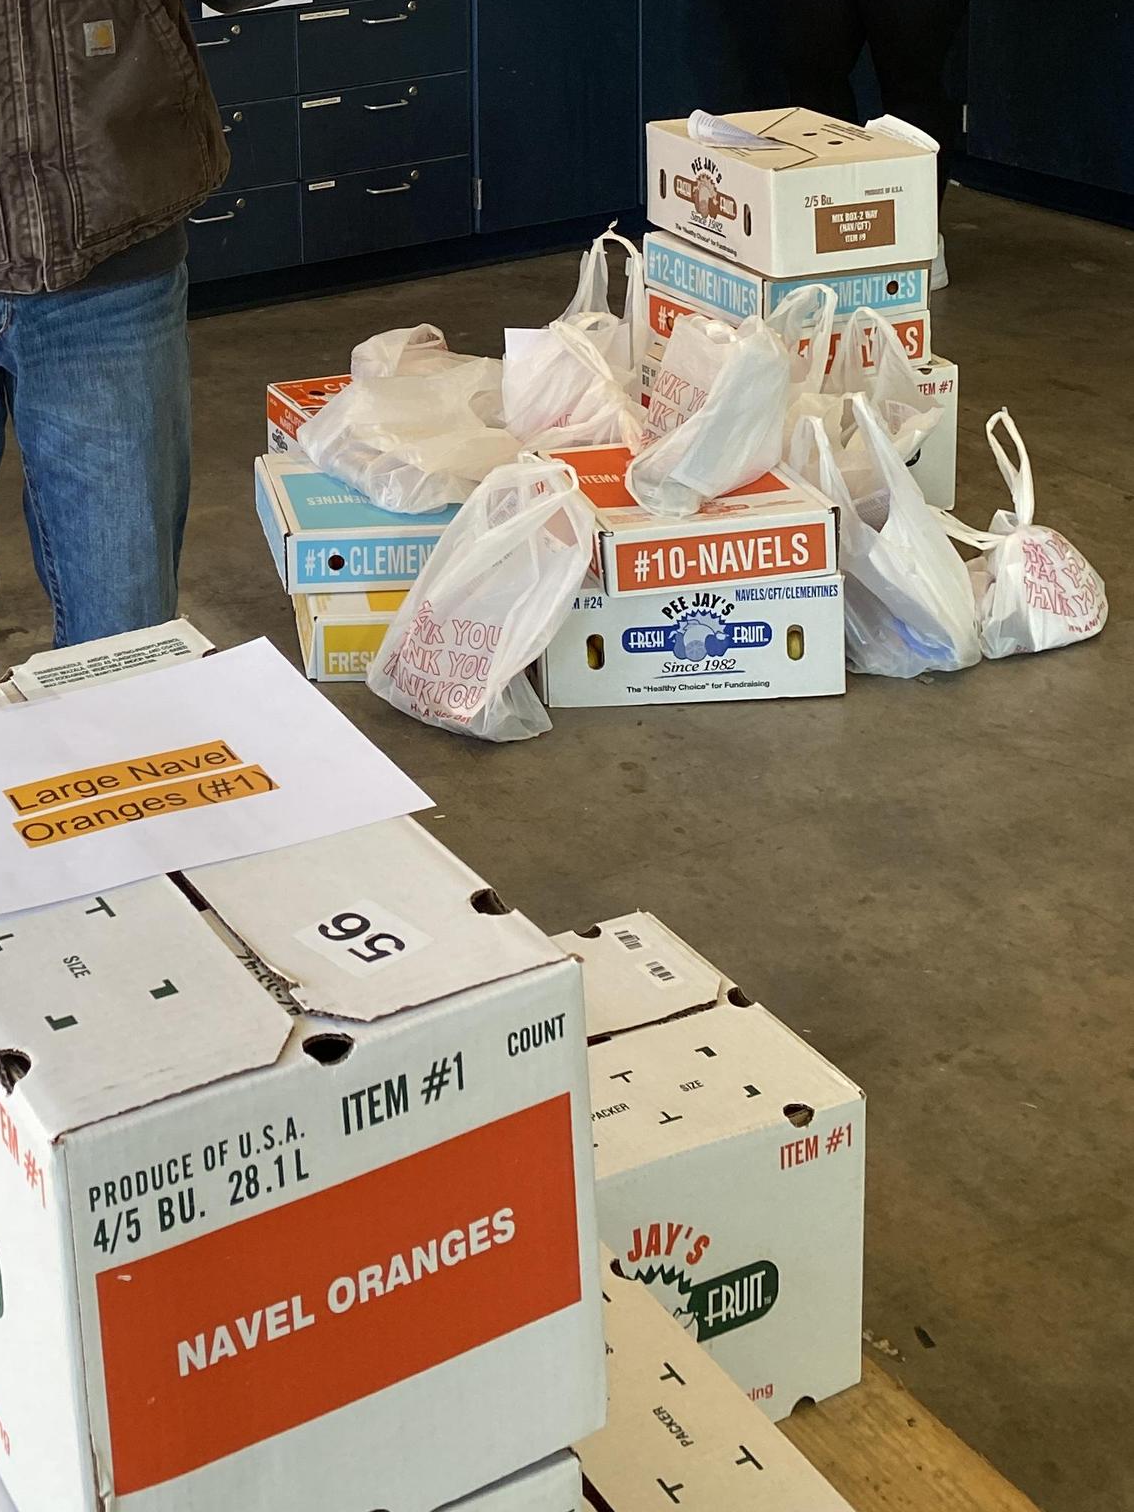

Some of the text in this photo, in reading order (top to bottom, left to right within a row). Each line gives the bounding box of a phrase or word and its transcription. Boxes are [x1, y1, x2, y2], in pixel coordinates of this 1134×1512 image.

[805, 195, 819, 208] 2/5
[832, 209, 878, 223] MIX BOX-2 WAY
[648, 246, 757, 316] #12-CLEMENTINES
[917, 379, 953, 396] TEM #7
[634, 532, 809, 583] #10-NAVELS
[583, 596, 603, 609] #24
[662, 593, 735, 620] PEE JAY'S
[735, 584, 838, 602] NAVELS/GFT/CLEMENTINES
[452, 620, 502, 653] YOU
[628, 630, 665, 649] FRESH
[732, 625, 765, 645] FRUIT
[449, 650, 492, 682] YOU
[662, 659, 736, 673] Since 1982
[434, 681, 486, 709] YOU
[626, 679, 770, 694] The "Healthy Choice" for Fundraising
[10, 744, 238, 813] Large Navel
[20, 768, 275, 844] Oranges (#1)
[316, 911, 407, 965] 56
[62, 953, 91, 979] SIZE
[507, 1013, 566, 1059] COUNT
[341, 1050, 466, 1137] ITEM #1
[679, 1080, 704, 1093] SIZE
[590, 1103, 630, 1122] PACKER
[780, 1123, 853, 1171] ITEM #1
[23, 1148, 47, 1209] #1
[88, 1117, 307, 1214] PRODUCE OF U.S.A.
[93, 1207, 143, 1255] 4/5
[157, 1187, 207, 1233] BU.
[627, 1221, 711, 1266] JAY'S
[176, 1206, 517, 1378] NAVEL ORANGES
[703, 1270, 766, 1328] FRUIT
[653, 1405, 694, 1448] PACKER
